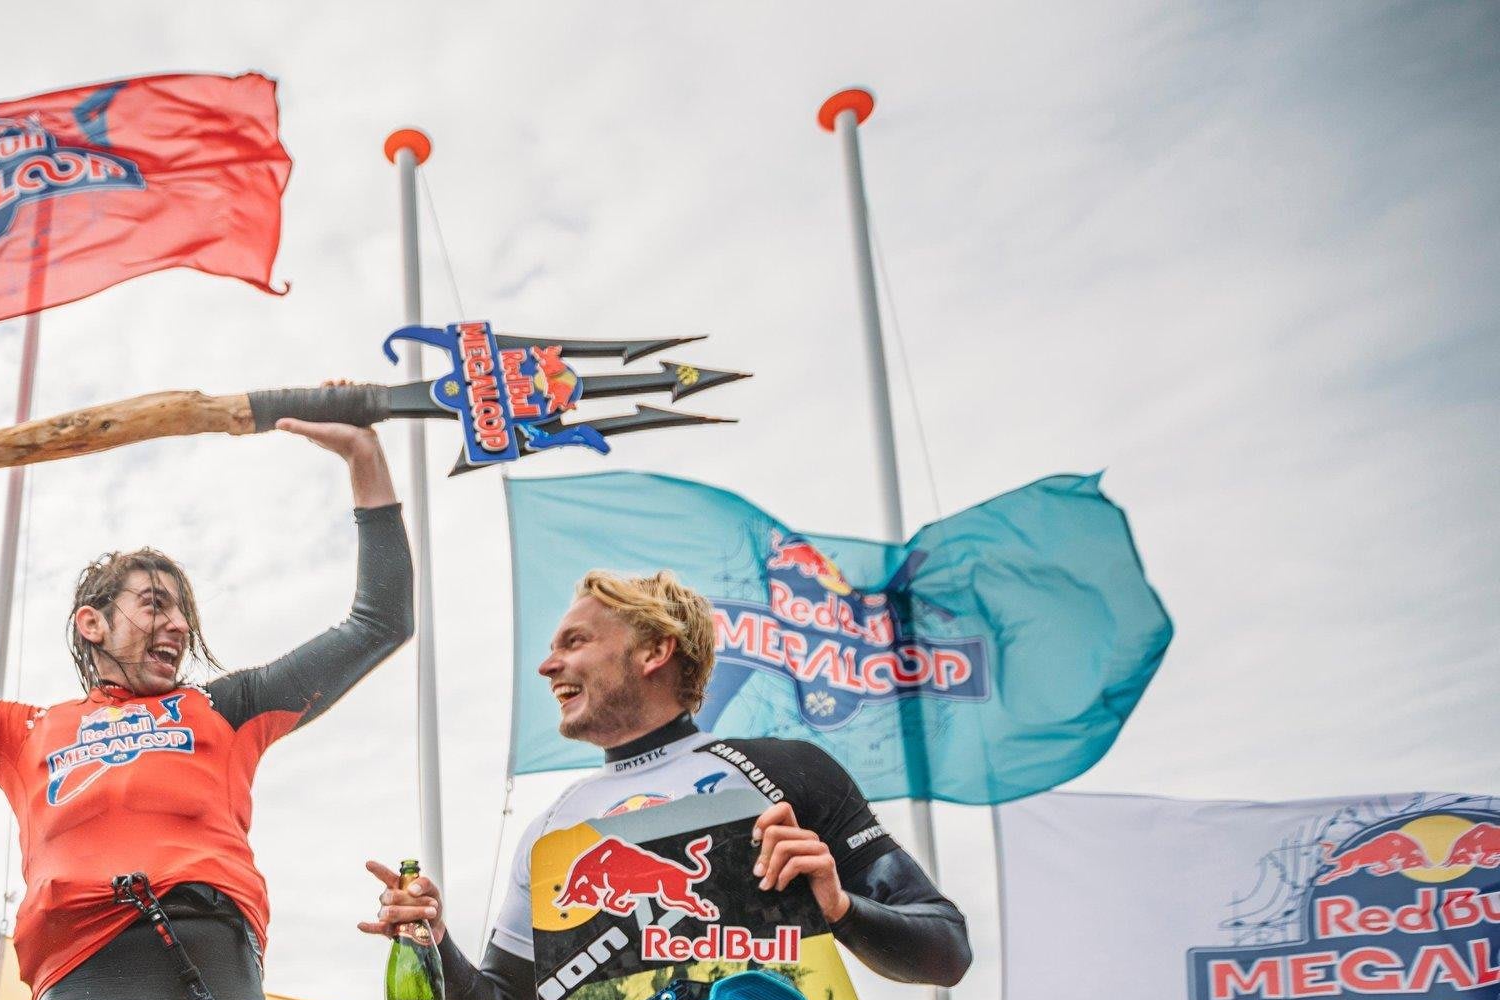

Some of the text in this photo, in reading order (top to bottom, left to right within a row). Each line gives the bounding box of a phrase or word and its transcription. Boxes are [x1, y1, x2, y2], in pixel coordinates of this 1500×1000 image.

[460, 321, 509, 452] MEGALOOP
[770, 579, 838, 633] Red
[53, 731, 187, 770] MEGALOOP
[82, 717, 151, 743] Red Bull
[623, 747, 667, 770] MYSTIC
[710, 742, 785, 803] SAMSUNG
[1316, 887, 1438, 939] Red
[641, 925, 802, 963] Red Bull
[1206, 938, 1500, 1000] MEGAL
